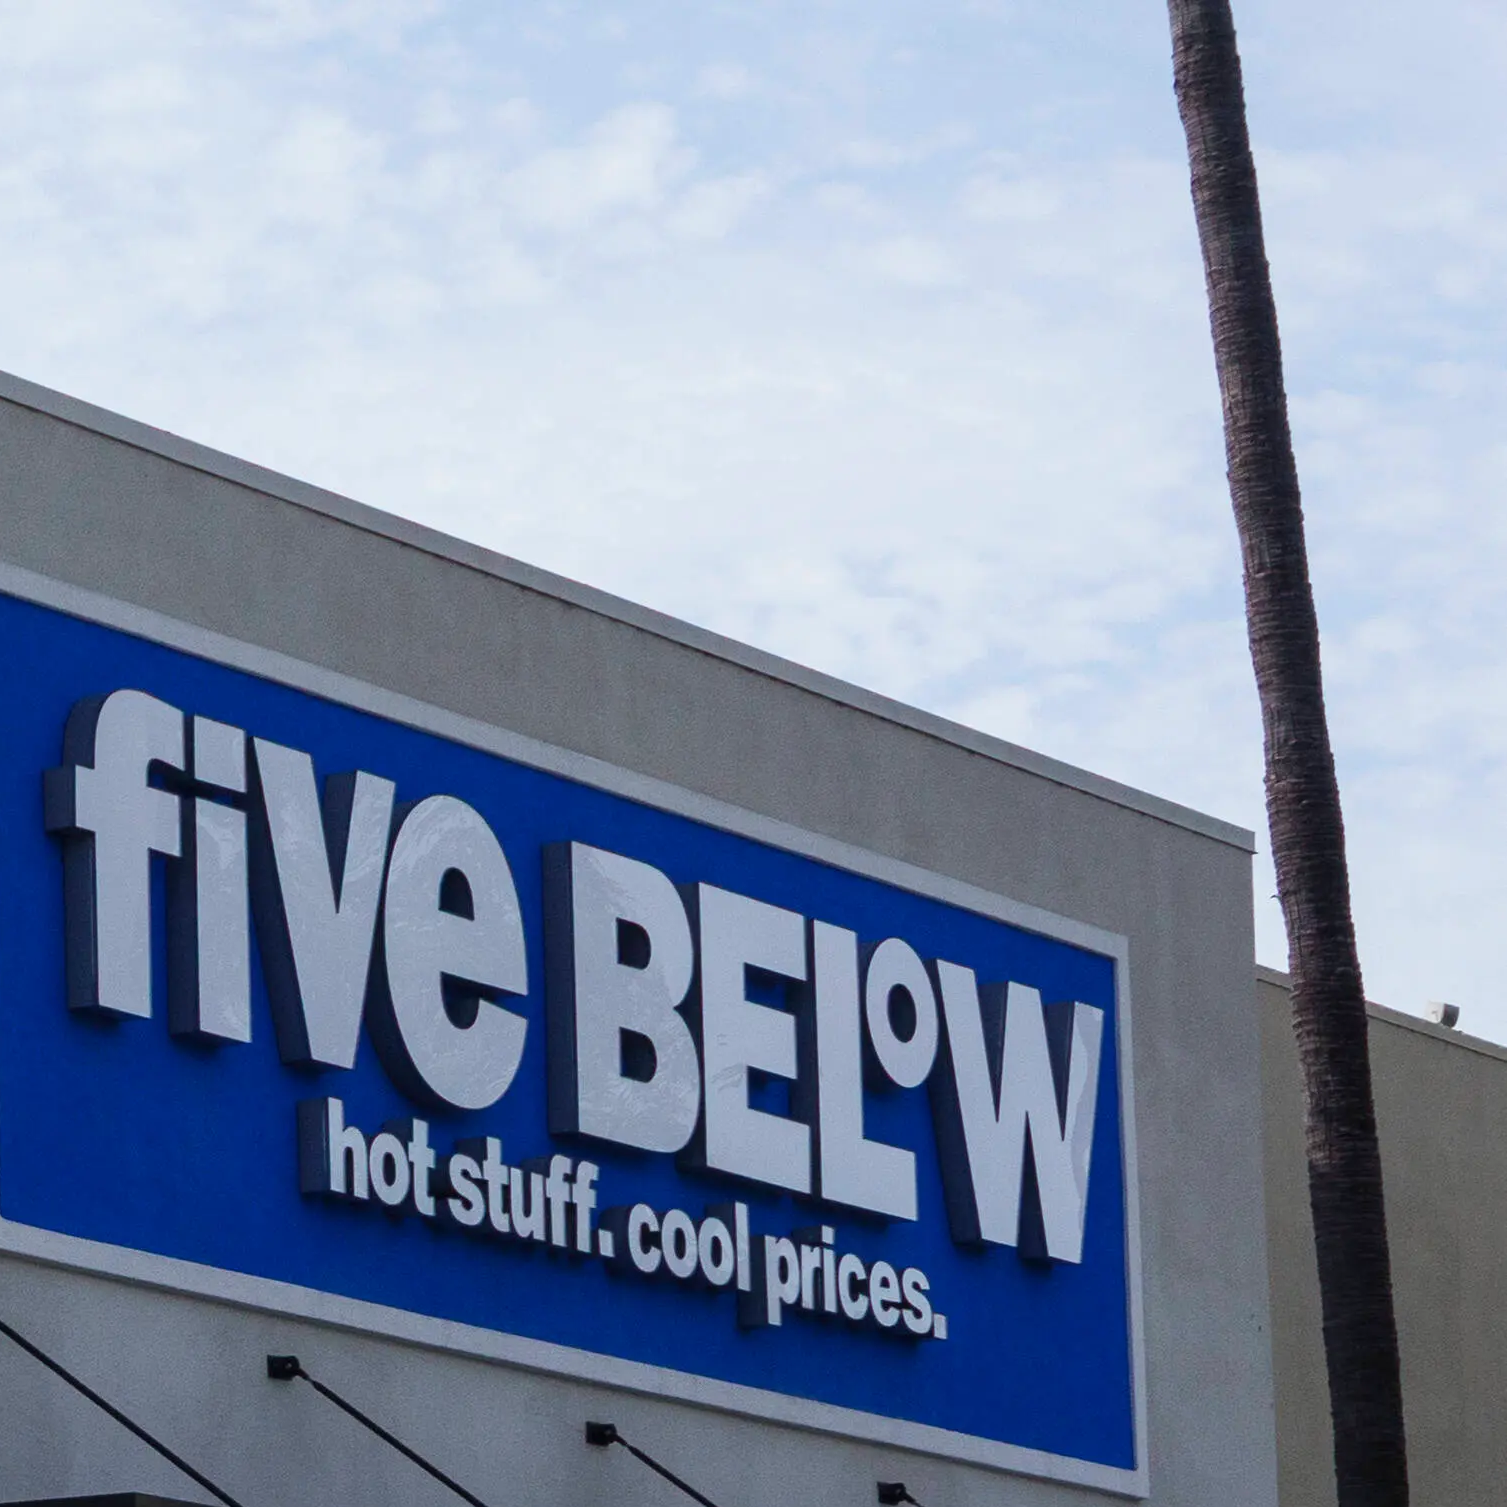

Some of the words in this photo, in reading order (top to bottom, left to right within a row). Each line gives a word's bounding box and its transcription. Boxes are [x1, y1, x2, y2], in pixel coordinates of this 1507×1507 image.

[66, 687, 529, 1111] five
[566, 840, 1104, 1265] BELOW
[325, 1096, 435, 1217] hot
[447, 1136, 616, 1259] stuff.
[626, 1201, 752, 1292] cool
[764, 1225, 949, 1341] prices.
